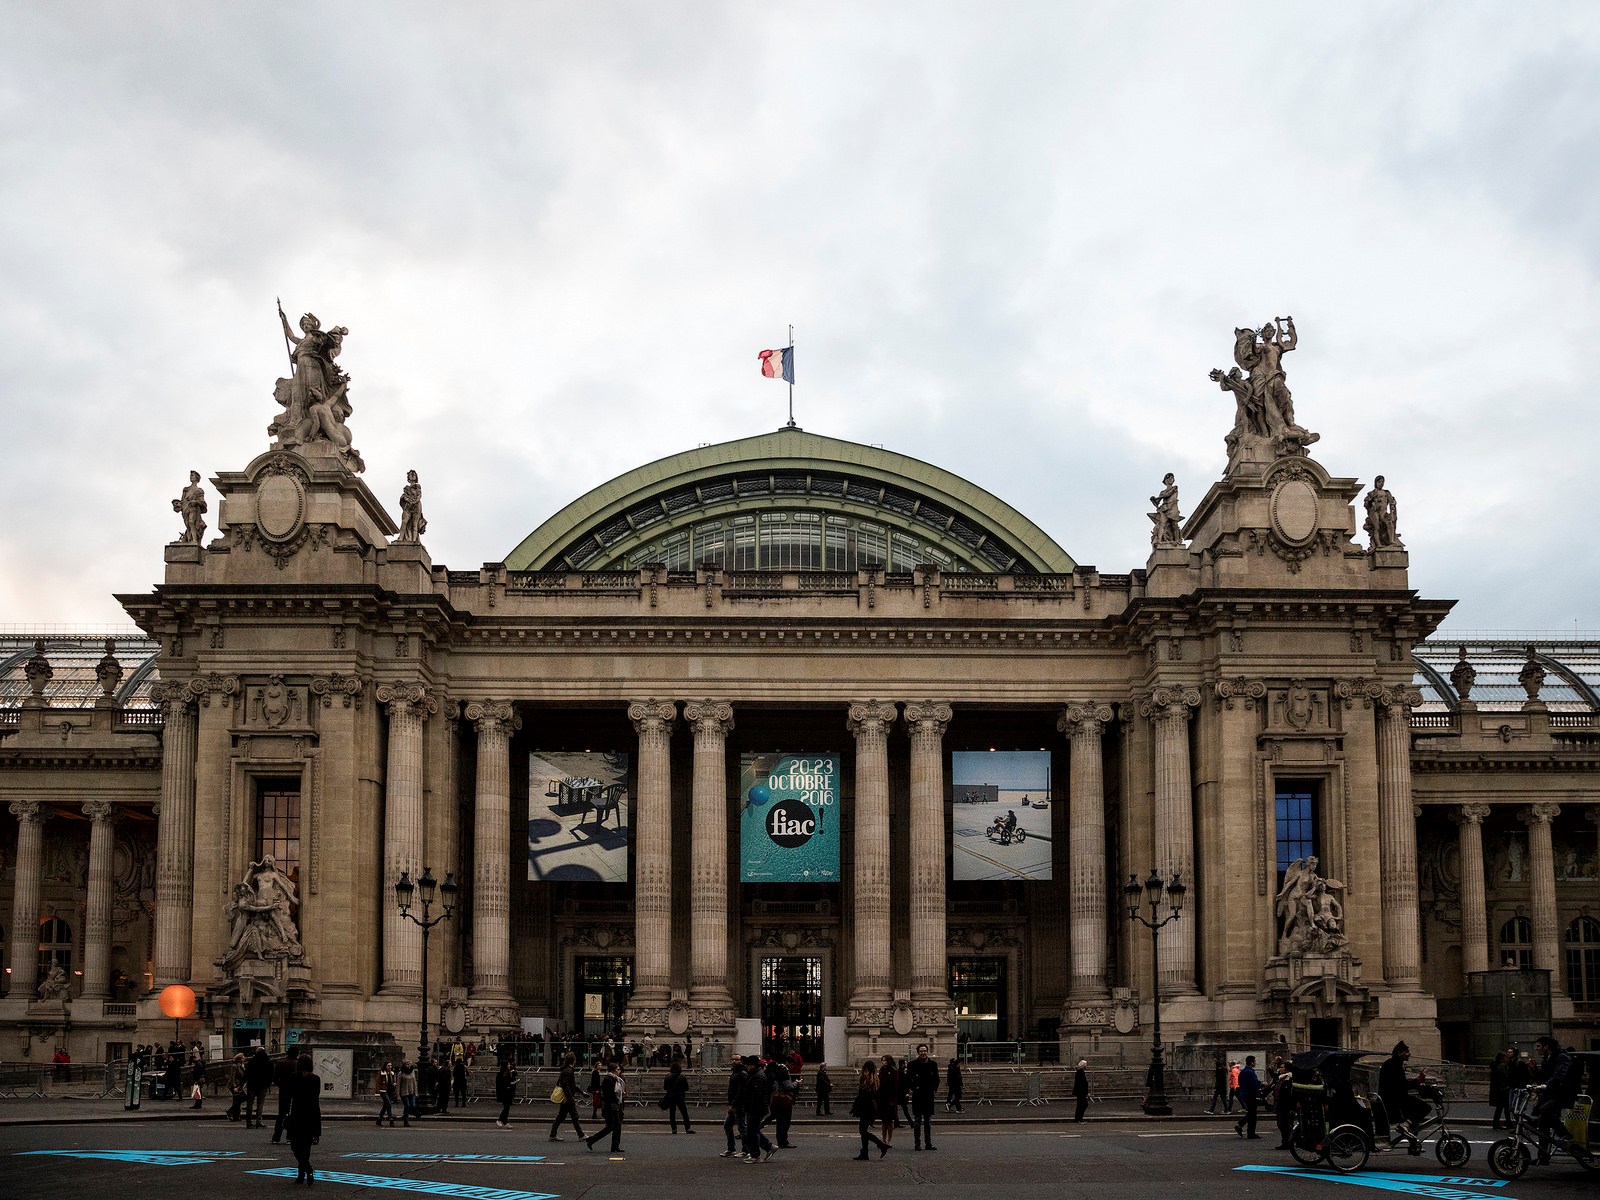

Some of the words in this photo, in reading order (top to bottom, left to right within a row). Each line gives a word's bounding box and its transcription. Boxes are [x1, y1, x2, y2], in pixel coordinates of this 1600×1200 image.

[790, 759, 834, 774] 20-23
[768, 774, 834, 790] OCTOBRE
[800, 790, 834, 806] 2016
